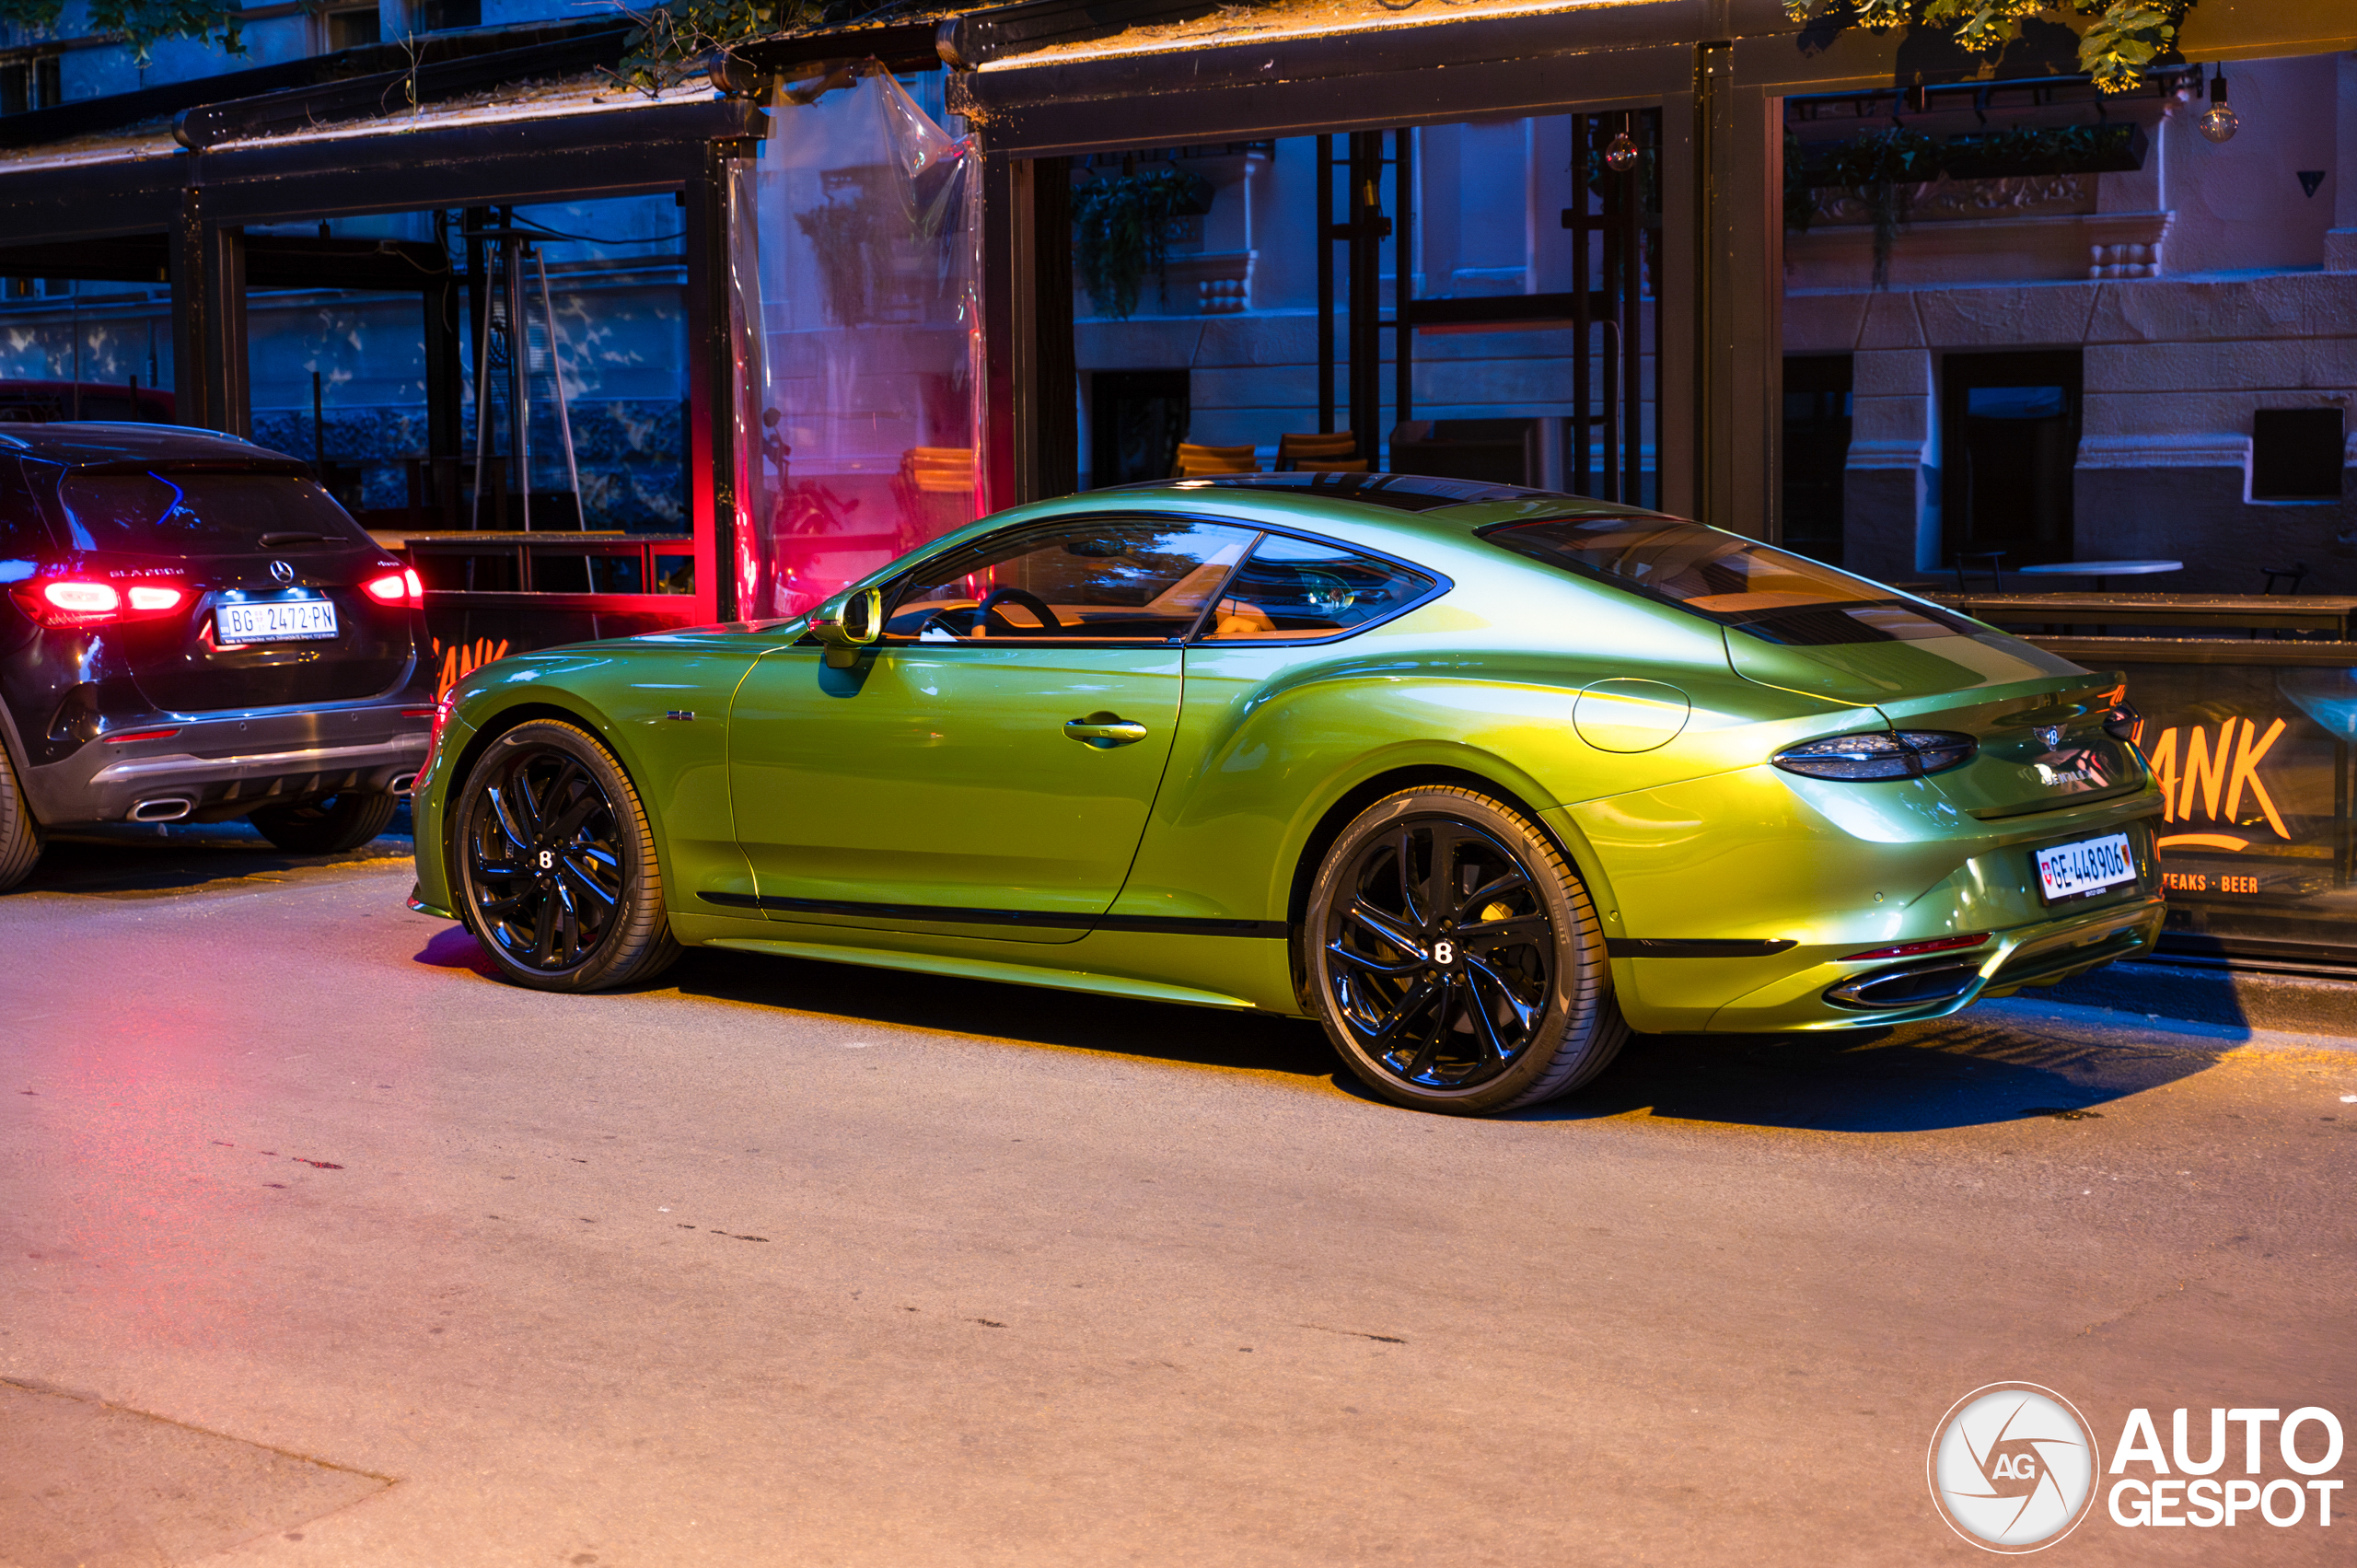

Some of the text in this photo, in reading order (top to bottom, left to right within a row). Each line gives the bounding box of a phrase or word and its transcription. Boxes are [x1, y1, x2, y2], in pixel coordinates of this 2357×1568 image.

[232, 610, 253, 633] BG
[2132, 715, 2292, 841] ANK
[539, 850, 553, 869] B
[2221, 876, 2258, 894] BEER
[1434, 942, 1453, 964] B
